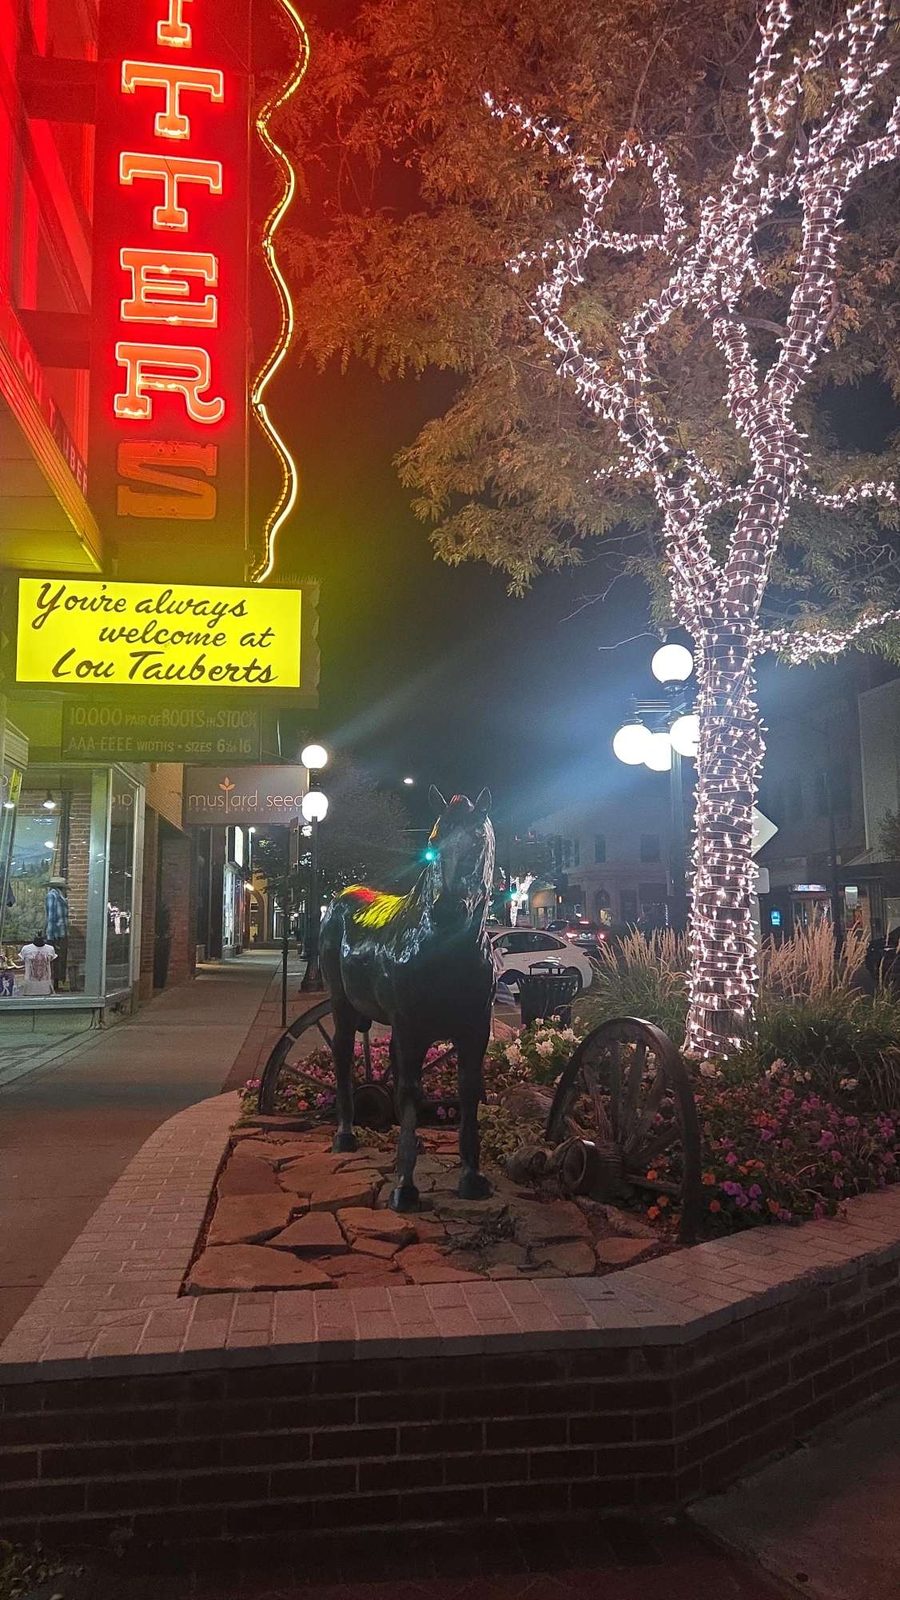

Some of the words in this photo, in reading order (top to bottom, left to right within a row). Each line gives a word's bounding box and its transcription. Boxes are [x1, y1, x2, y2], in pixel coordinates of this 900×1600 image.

[31, 583, 127, 629] You're
[135, 589, 248, 627] always
[99, 620, 227, 647] welcome
[239, 627, 275, 647] at
[52, 648, 116, 678] Lou
[128, 651, 278, 683] Tauberts
[70, 707, 123, 727] 10,000
[148, 714, 162, 727] OF
[162, 709, 205, 728] BOOTS
[216, 710, 257, 728] STOCK
[185, 741, 212, 752] SIZES
[239, 738, 252, 752] 16
[188, 788, 258, 813] mustard
[266, 790, 304, 807] seed
